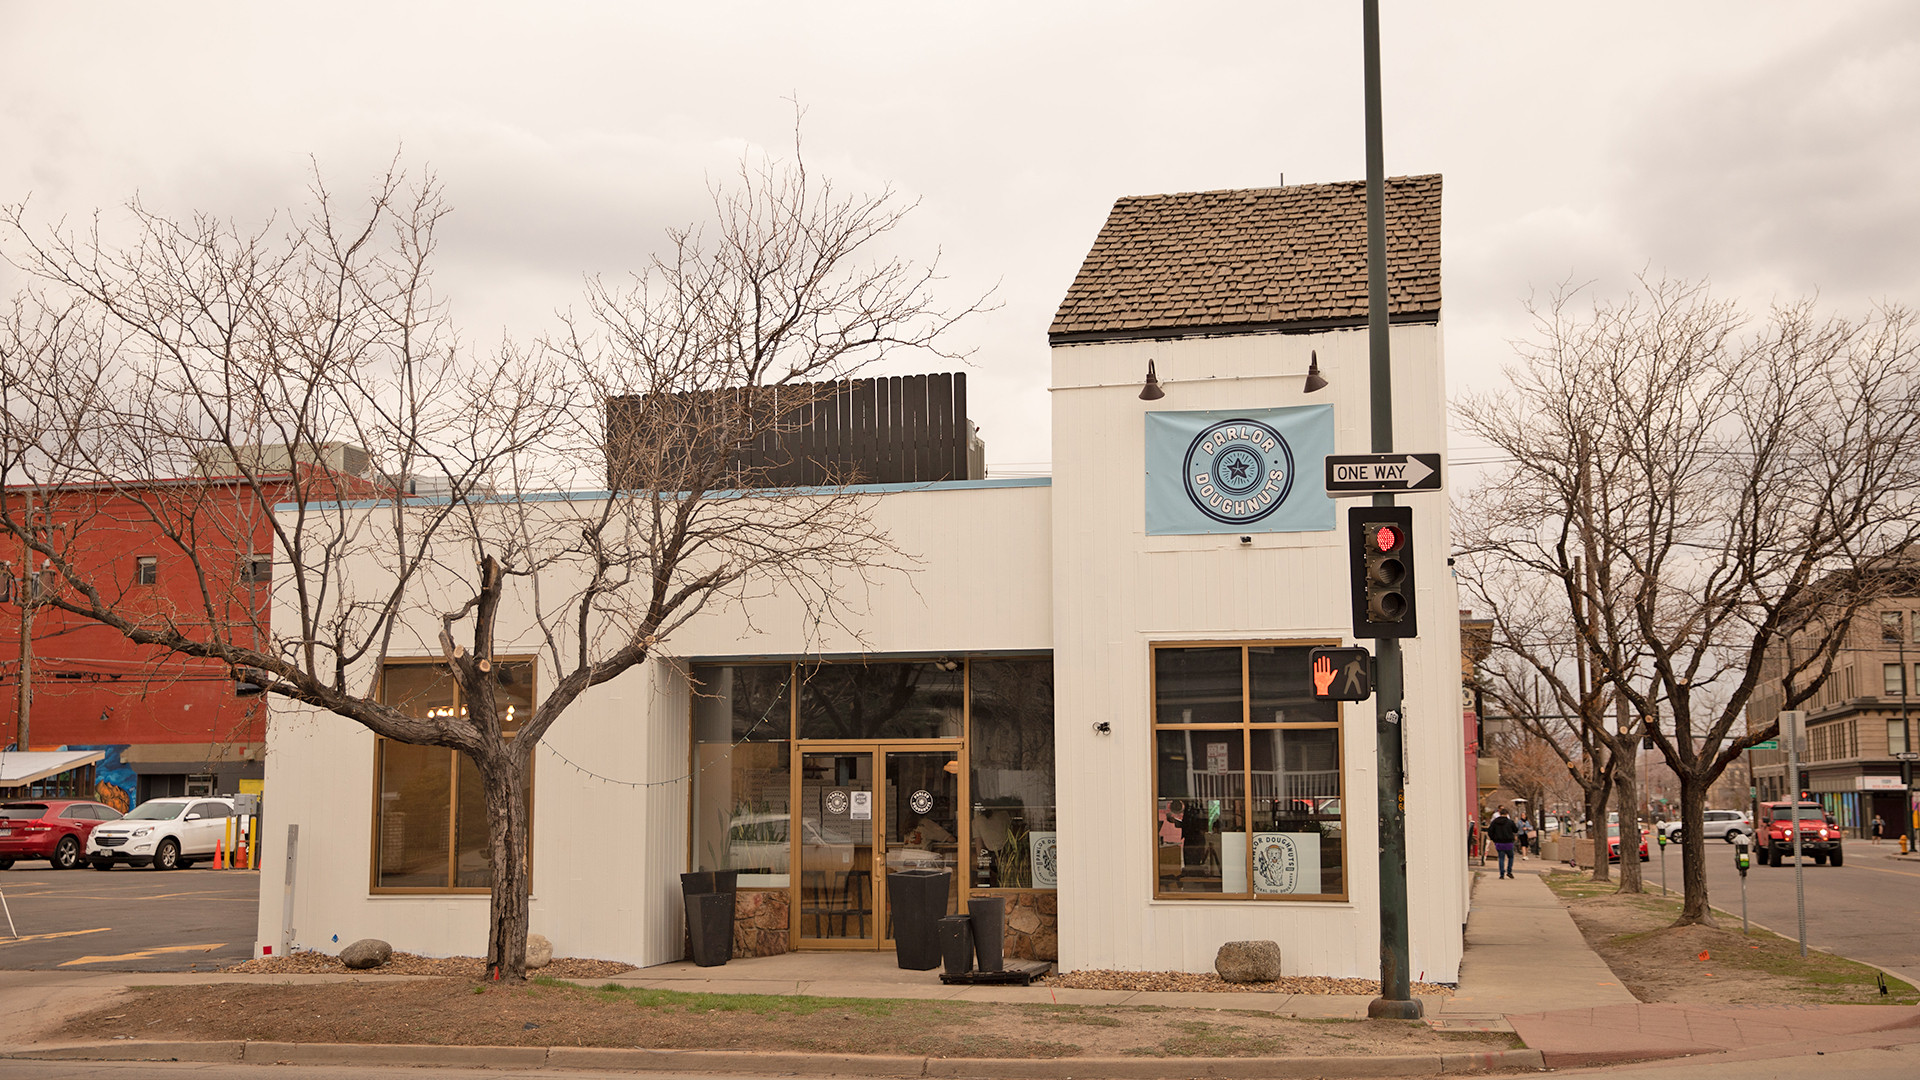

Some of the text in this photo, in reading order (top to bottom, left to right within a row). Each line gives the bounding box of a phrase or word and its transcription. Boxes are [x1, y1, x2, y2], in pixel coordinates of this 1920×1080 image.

[1202, 426, 1276, 455] PARLOR
[1337, 464, 1407, 480] ONE WAY
[1195, 469, 1285, 515] DOUGHNUTS
[1265, 837, 1295, 867] DOUGHNUTS
